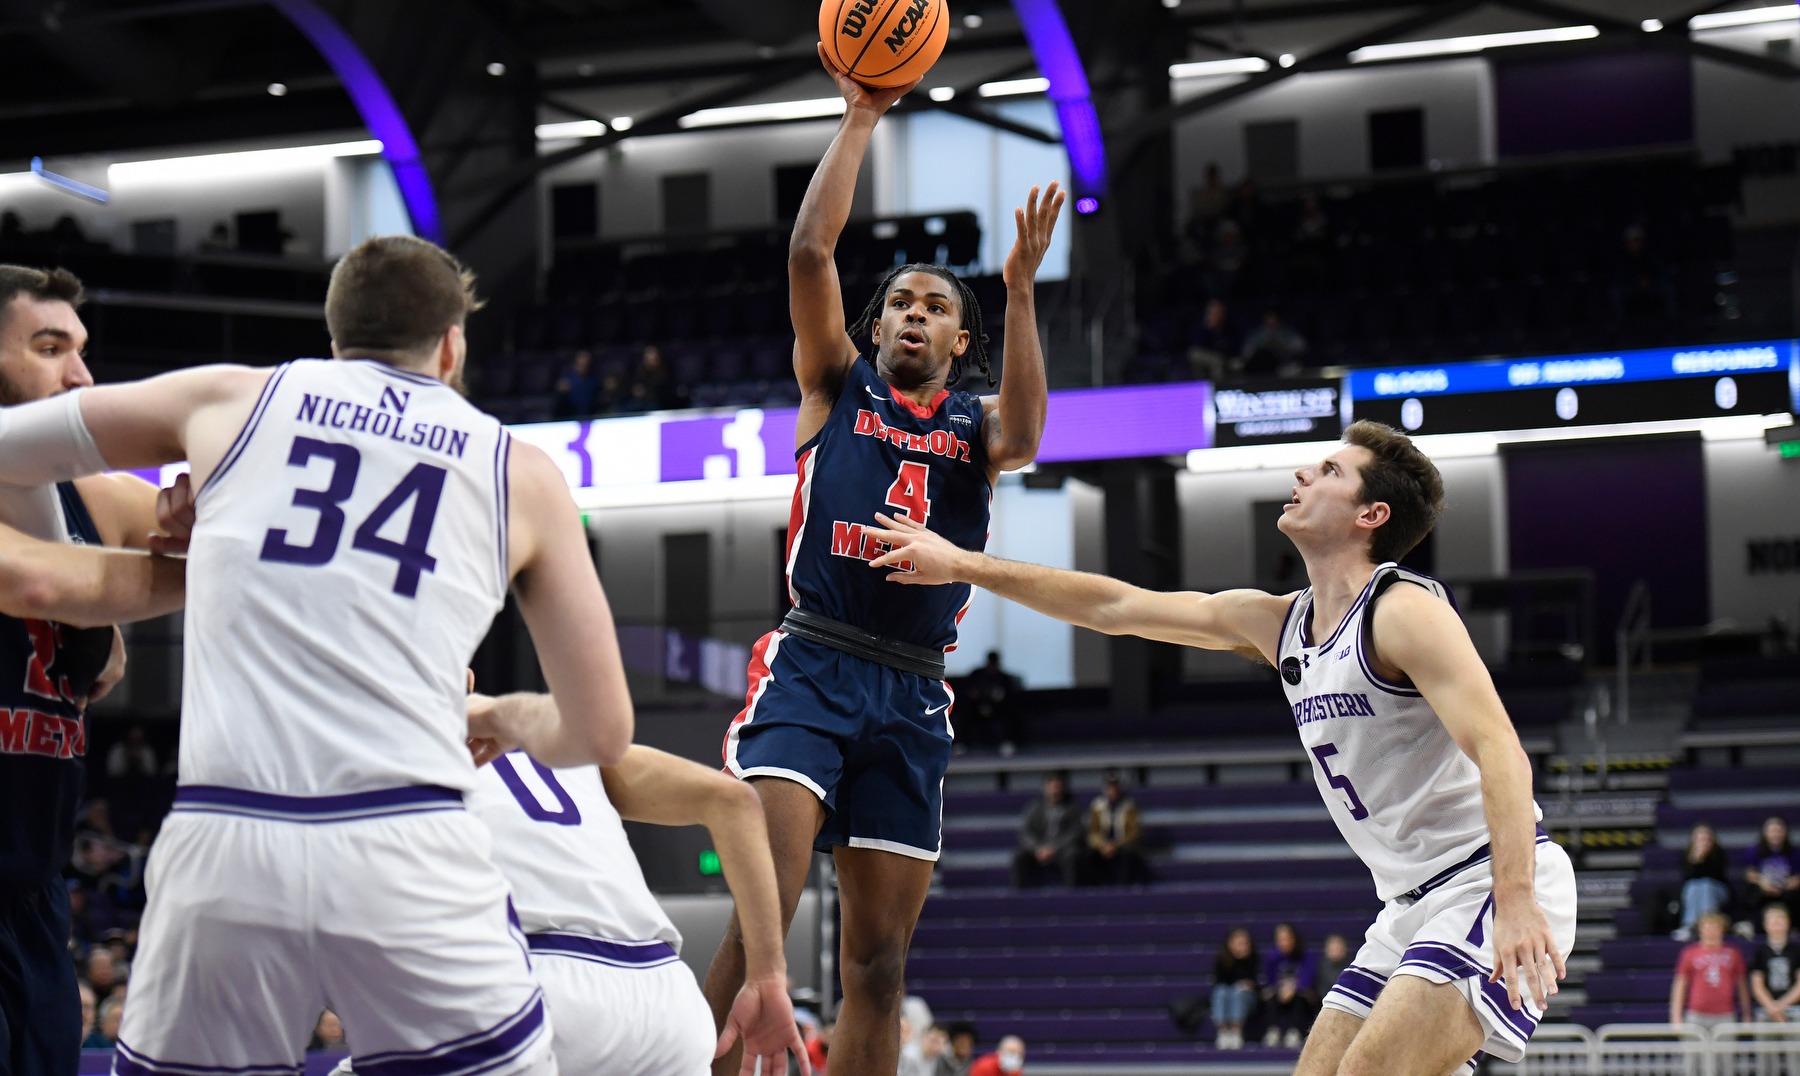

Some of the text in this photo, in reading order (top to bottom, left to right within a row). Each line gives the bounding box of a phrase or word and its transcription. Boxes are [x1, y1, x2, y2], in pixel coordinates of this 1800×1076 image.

[296, 393, 470, 460] NICHOLSON
[258, 434, 448, 600] 34
[885, 460, 931, 528] 4
[1311, 742, 1369, 821] 5
